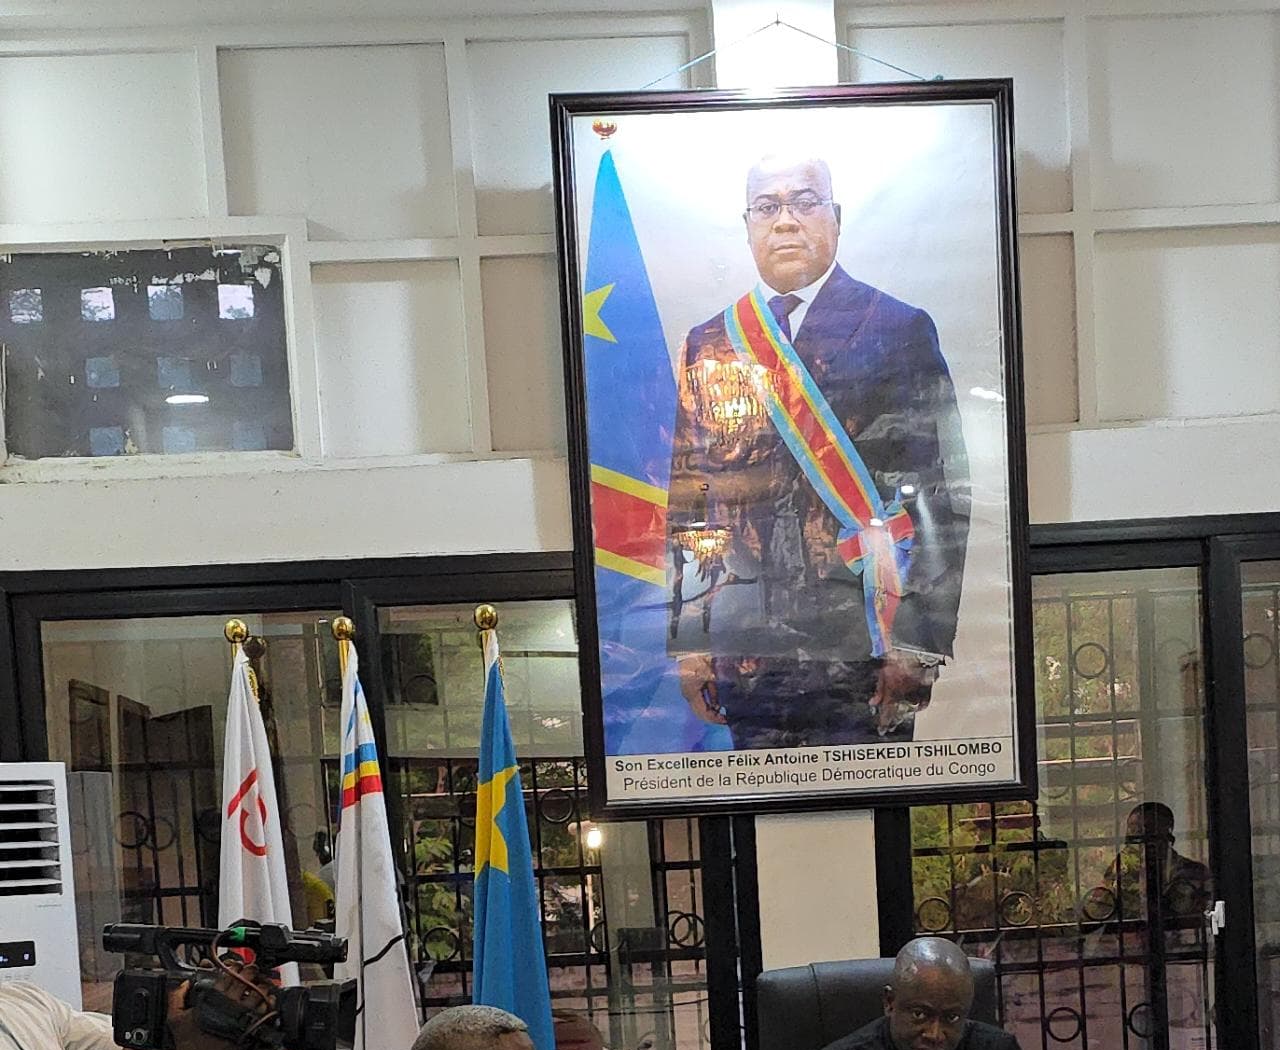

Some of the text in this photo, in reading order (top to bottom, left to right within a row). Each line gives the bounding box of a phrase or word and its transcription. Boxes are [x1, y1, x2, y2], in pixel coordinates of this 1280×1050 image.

[615, 742, 1002, 772] Son Excellence Félix Antoine TSHISEKEDI TSHILOMBO
[624, 761, 996, 791] Président de la République Démocratique du Congo
